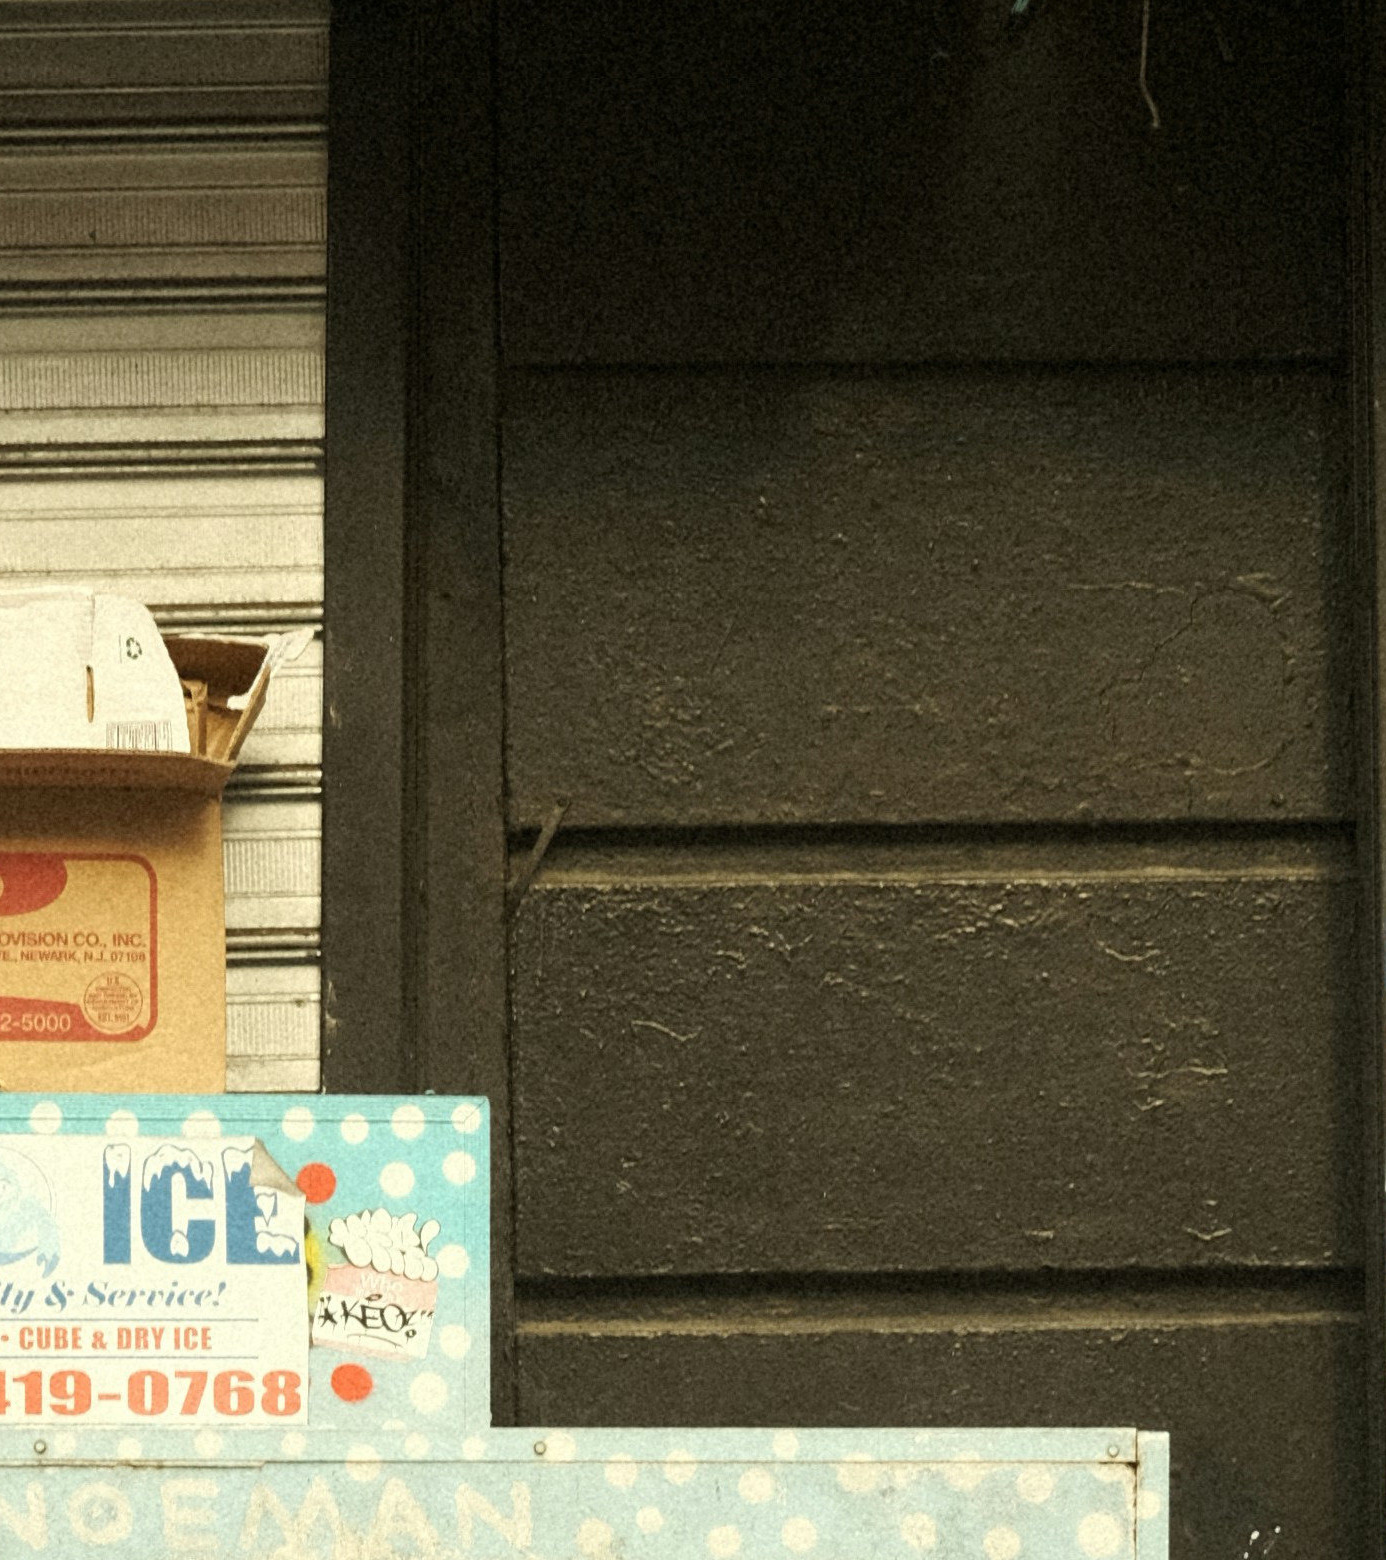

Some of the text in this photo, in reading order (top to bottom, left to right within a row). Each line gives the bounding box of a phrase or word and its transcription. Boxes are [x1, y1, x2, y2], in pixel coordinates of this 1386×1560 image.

[112, 932, 147, 949] INC.
[100, 1142, 306, 1266] ICE
[48, 1280, 74, 1309] &
[88, 1278, 228, 1310] Service!
[18, 1326, 85, 1352] CUBE
[91, 1327, 109, 1351] &
[117, 1326, 165, 1352] DRY
[173, 1326, 213, 1352] ICE
